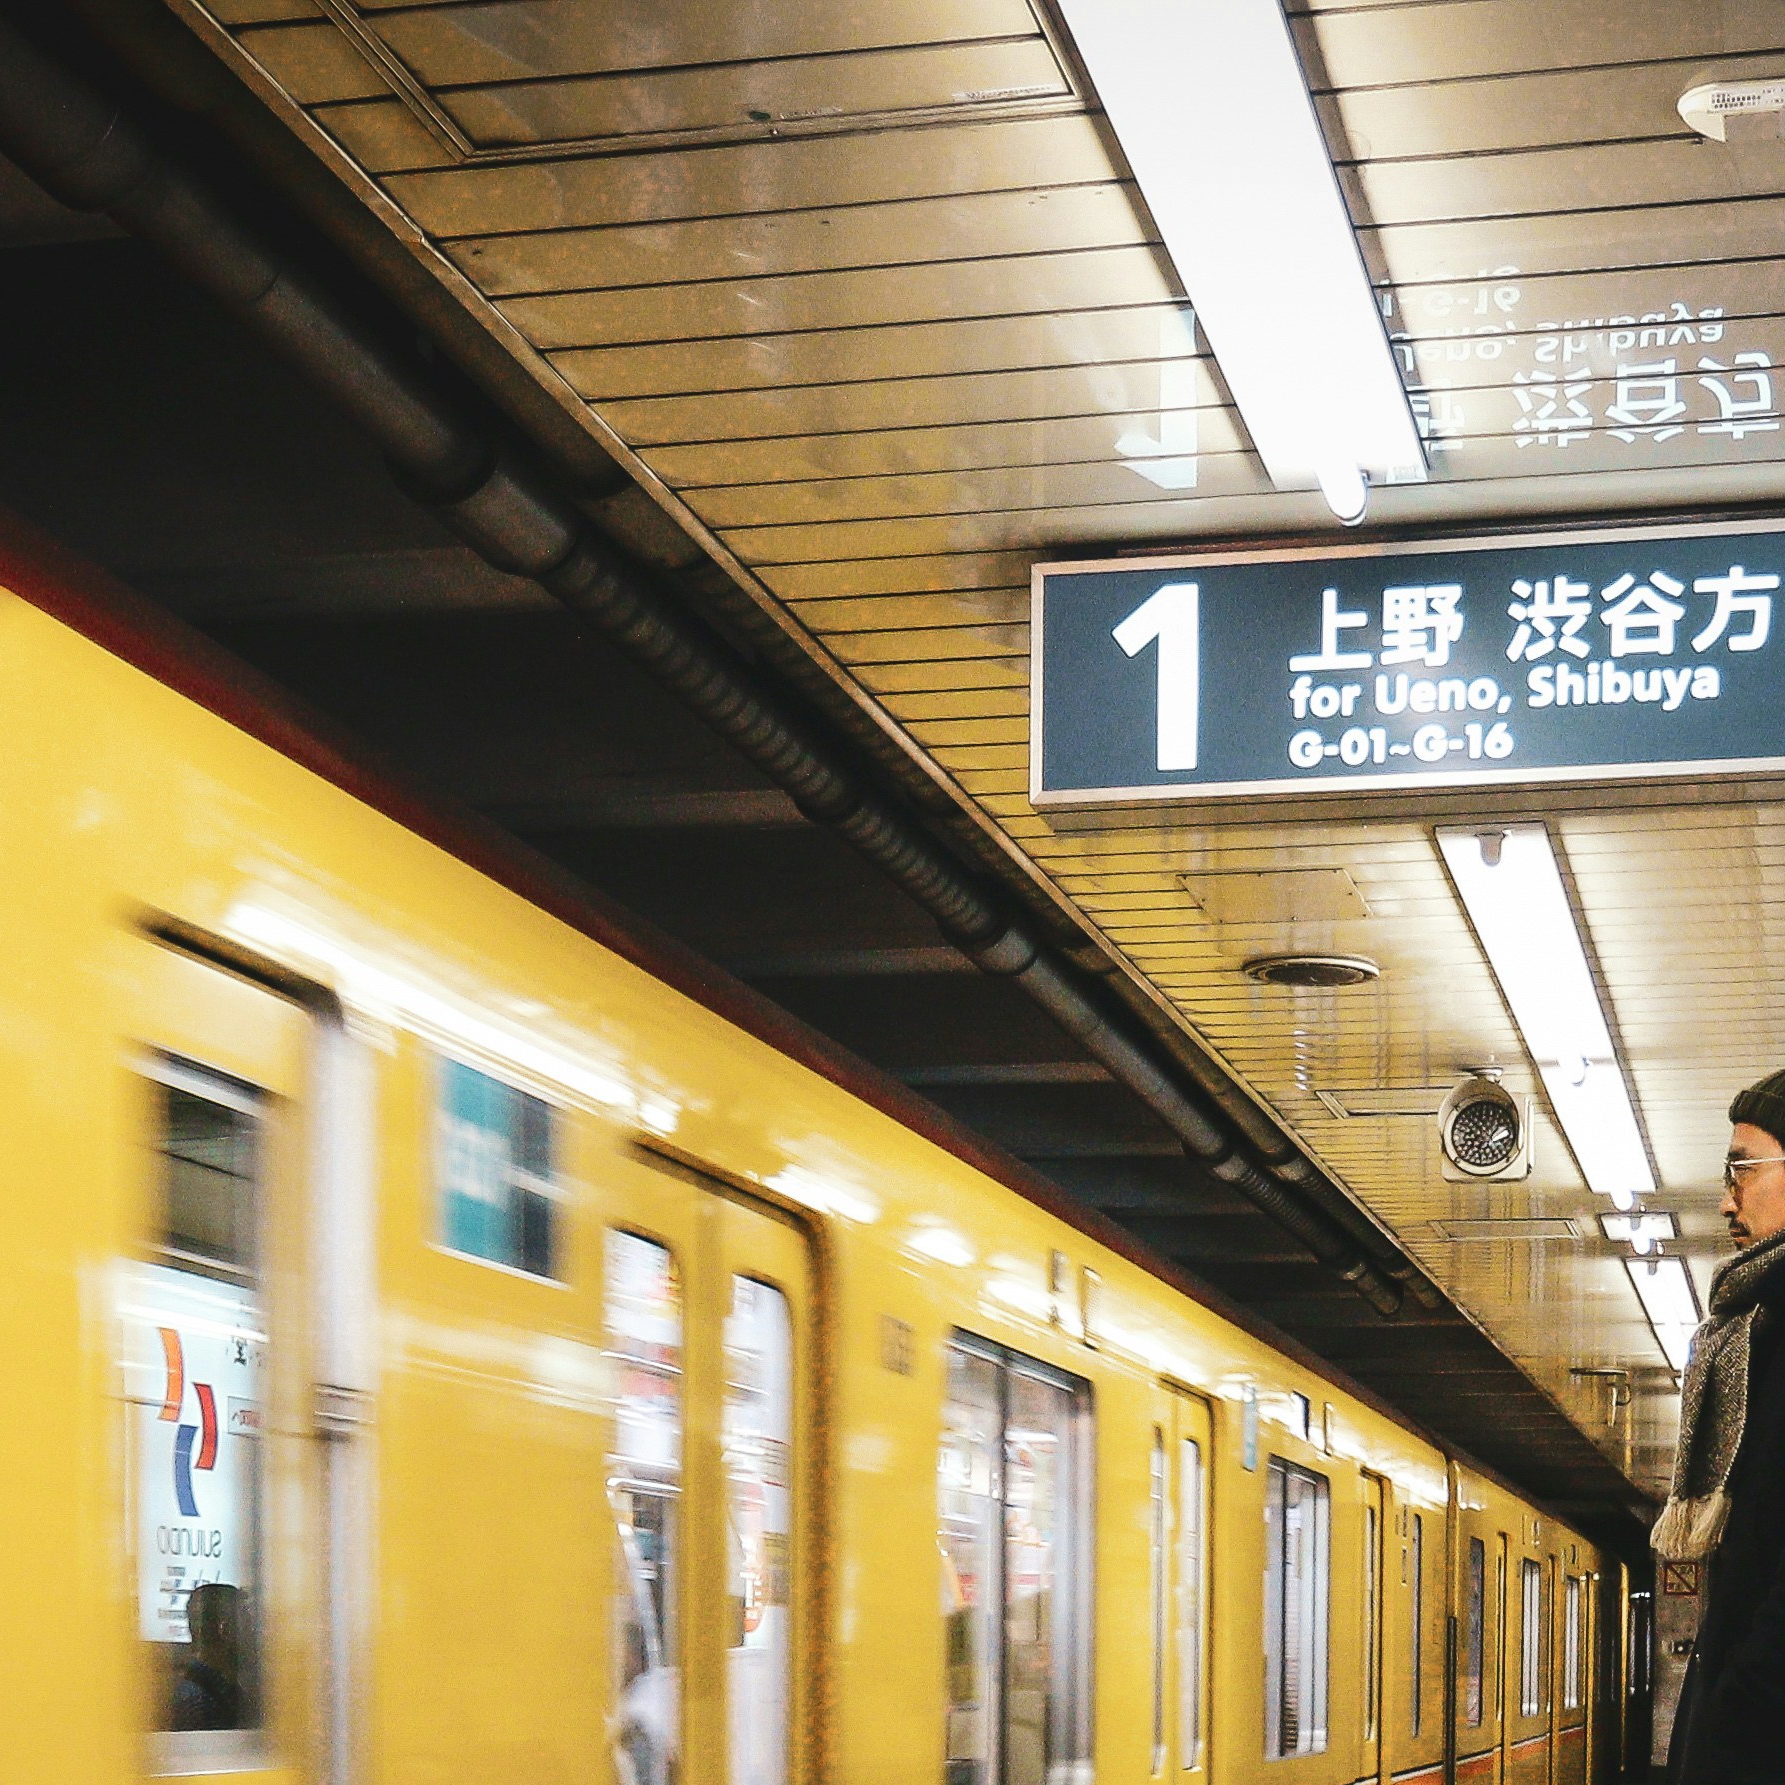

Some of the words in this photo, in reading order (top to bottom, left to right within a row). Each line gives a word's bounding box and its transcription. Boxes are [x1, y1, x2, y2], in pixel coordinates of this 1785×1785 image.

[1289, 584, 1465, 671] 上野
[1112, 583, 1199, 771] 1
[1290, 676, 1362, 721] for
[1375, 669, 1512, 719] Ueno,
[1526, 660, 1720, 711] Shibuya
